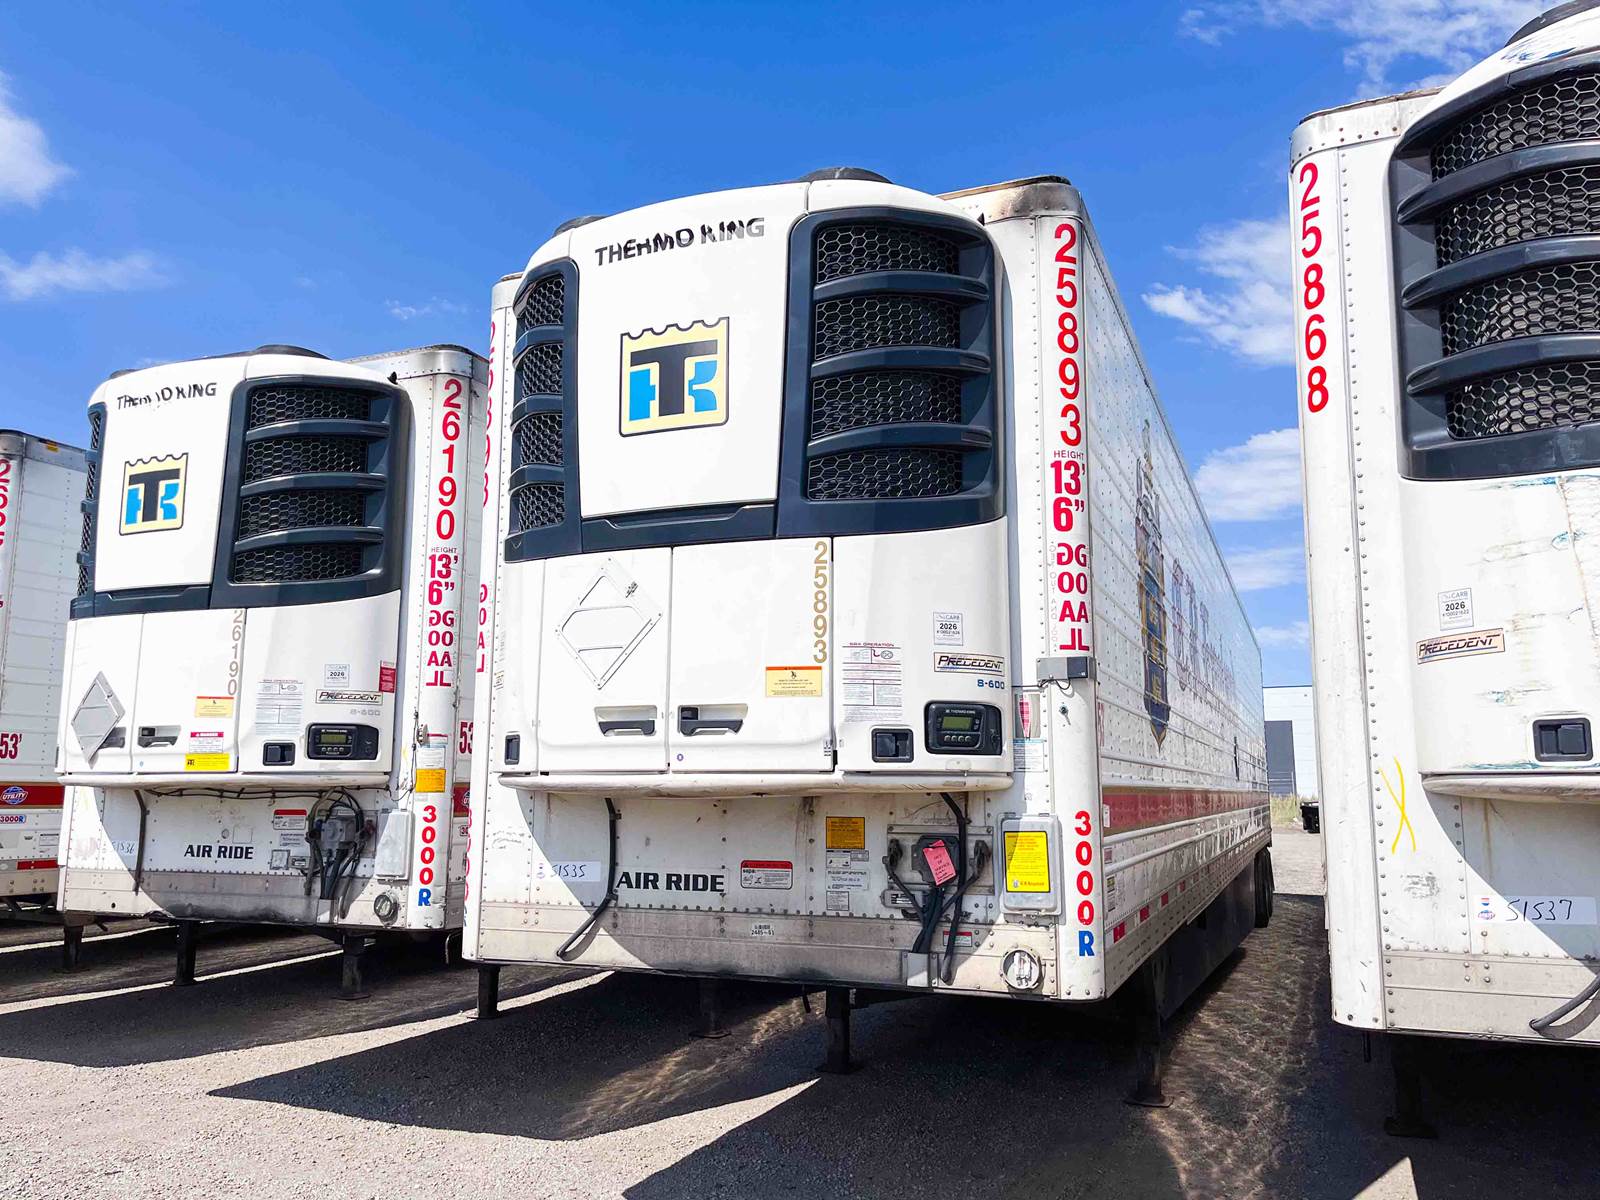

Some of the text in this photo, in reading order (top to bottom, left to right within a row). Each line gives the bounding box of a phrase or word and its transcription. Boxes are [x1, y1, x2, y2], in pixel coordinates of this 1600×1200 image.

[700, 217, 765, 245] KING
[1299, 162, 1329, 413] 25868
[1054, 223, 1082, 447] 25893
[436, 378, 463, 540] 26190
[813, 540, 828, 664] 25893
[1445, 601, 1466, 612] 2026
[939, 622, 958, 630] 2026
[227, 609, 243, 696] 26190
[1418, 633, 1500, 657] PRECEDENT
[938, 655, 1004, 670] PRECEDENT
[319, 691, 381, 701] PRECEDENT
[2, 791, 27, 801] UTILITY
[184, 844, 254, 860] AIR RIDE
[418, 804, 437, 907] 3000R
[616, 871, 660, 890] AIR
[666, 873, 725, 893] RIDE
[1074, 810, 1095, 957] 3000R
